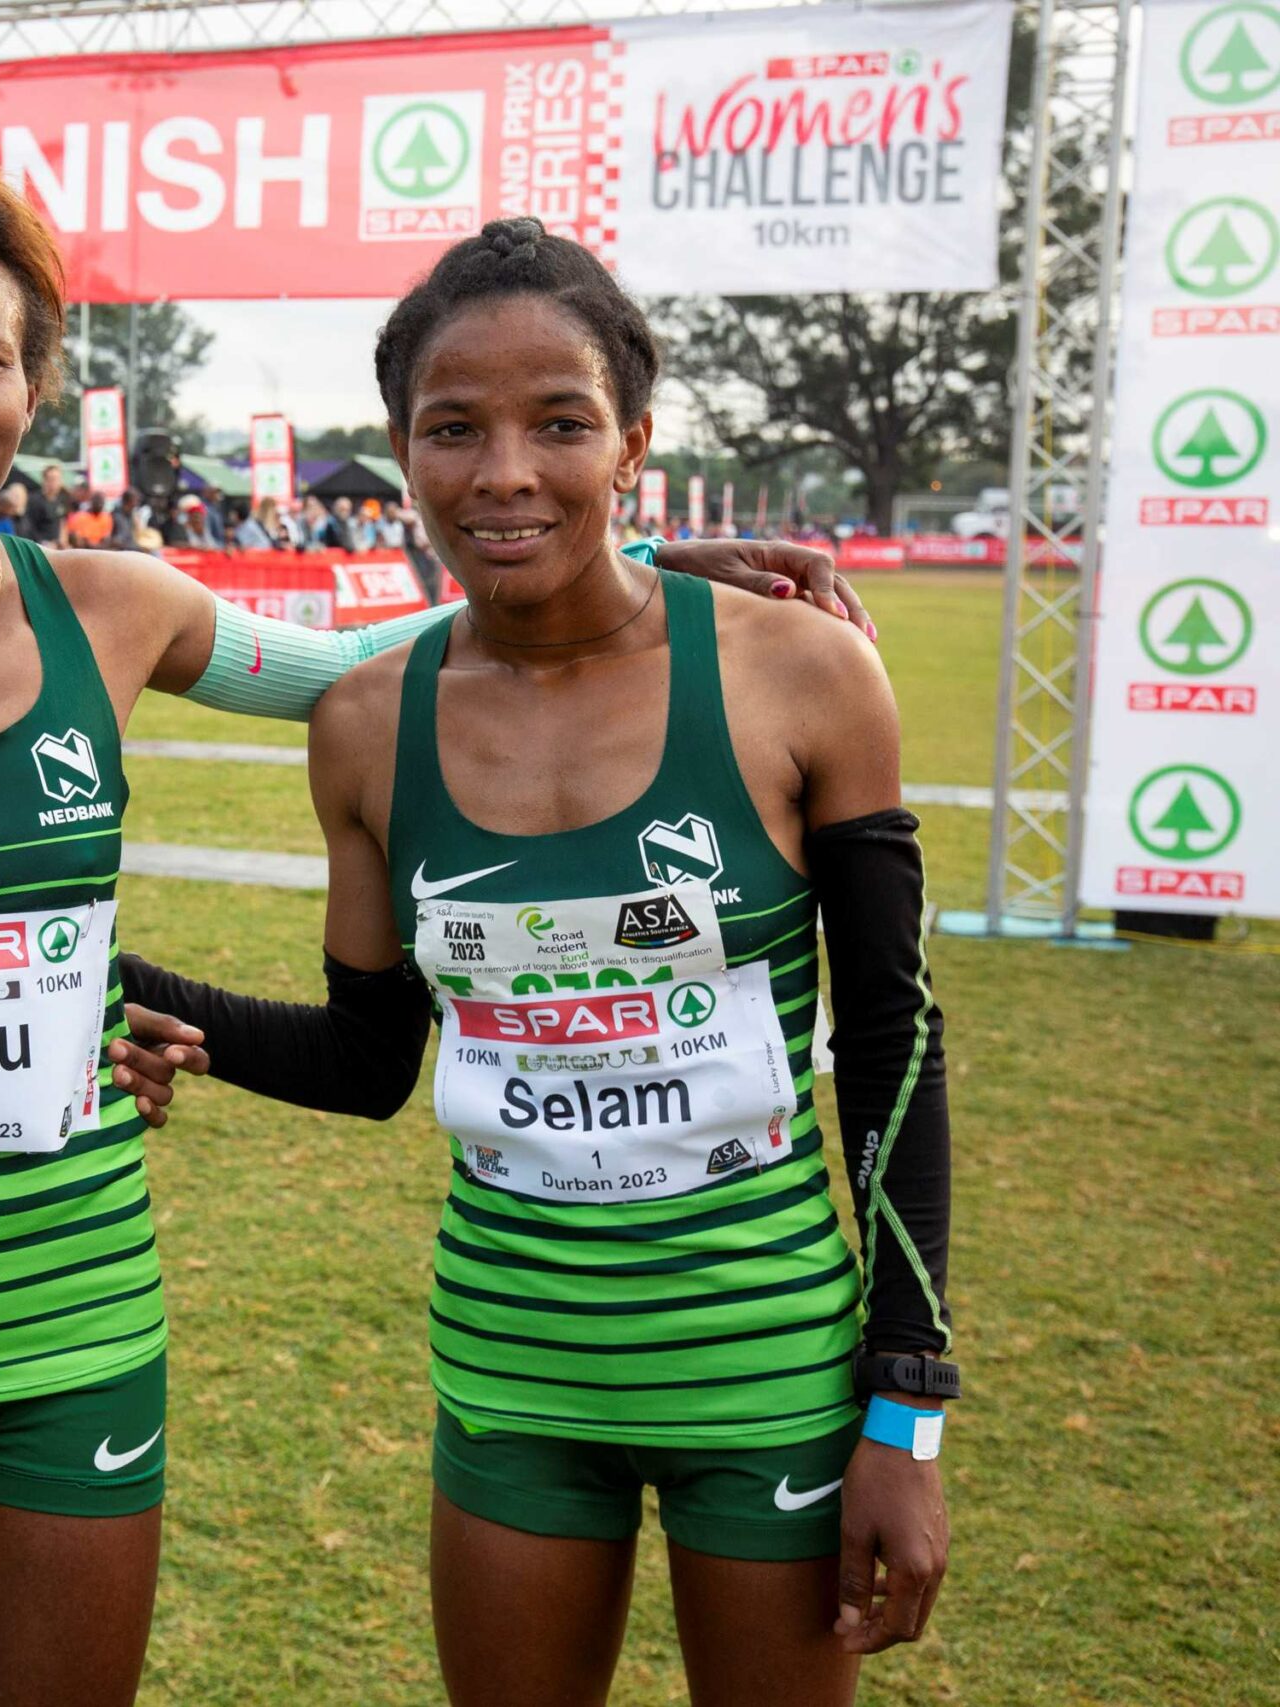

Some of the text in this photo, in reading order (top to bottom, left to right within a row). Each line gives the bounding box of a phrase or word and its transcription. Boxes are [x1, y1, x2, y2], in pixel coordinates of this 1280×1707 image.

[793, 54, 887, 77] SPAR
[654, 60, 969, 173] Women's
[499, 61, 535, 218] AND PRIX
[651, 139, 966, 211] CHALLENGE
[369, 207, 472, 235] SPAR
[754, 219, 851, 247] 10km
[1154, 308, 1280, 335] SPAR
[1142, 498, 1266, 524] SPAR
[1131, 685, 1254, 713] SPAR
[38, 802, 114, 826] NEDBANK
[1118, 870, 1242, 897] SPAR
[623, 901, 684, 931] ASA
[443, 920, 486, 940] KZNA
[551, 930, 584, 943] Road
[435, 946, 712, 975] Covering or removal of logos above will lead to disqualification
[448, 943, 485, 961] 2023
[536, 941, 588, 954] Accident
[560, 951, 589, 964] Fund
[36, 971, 82, 995] 10KM
[494, 1000, 655, 1038] SPAR
[455, 1047, 501, 1067] 10KM
[670, 1031, 728, 1059] 10KM
[765, 1039, 781, 1095] Lucky Draw
[499, 1077, 692, 1132] Selam
[592, 1150, 601, 1169] 1
[711, 1141, 744, 1165] ASA
[542, 1168, 668, 1191] Durban 2023
